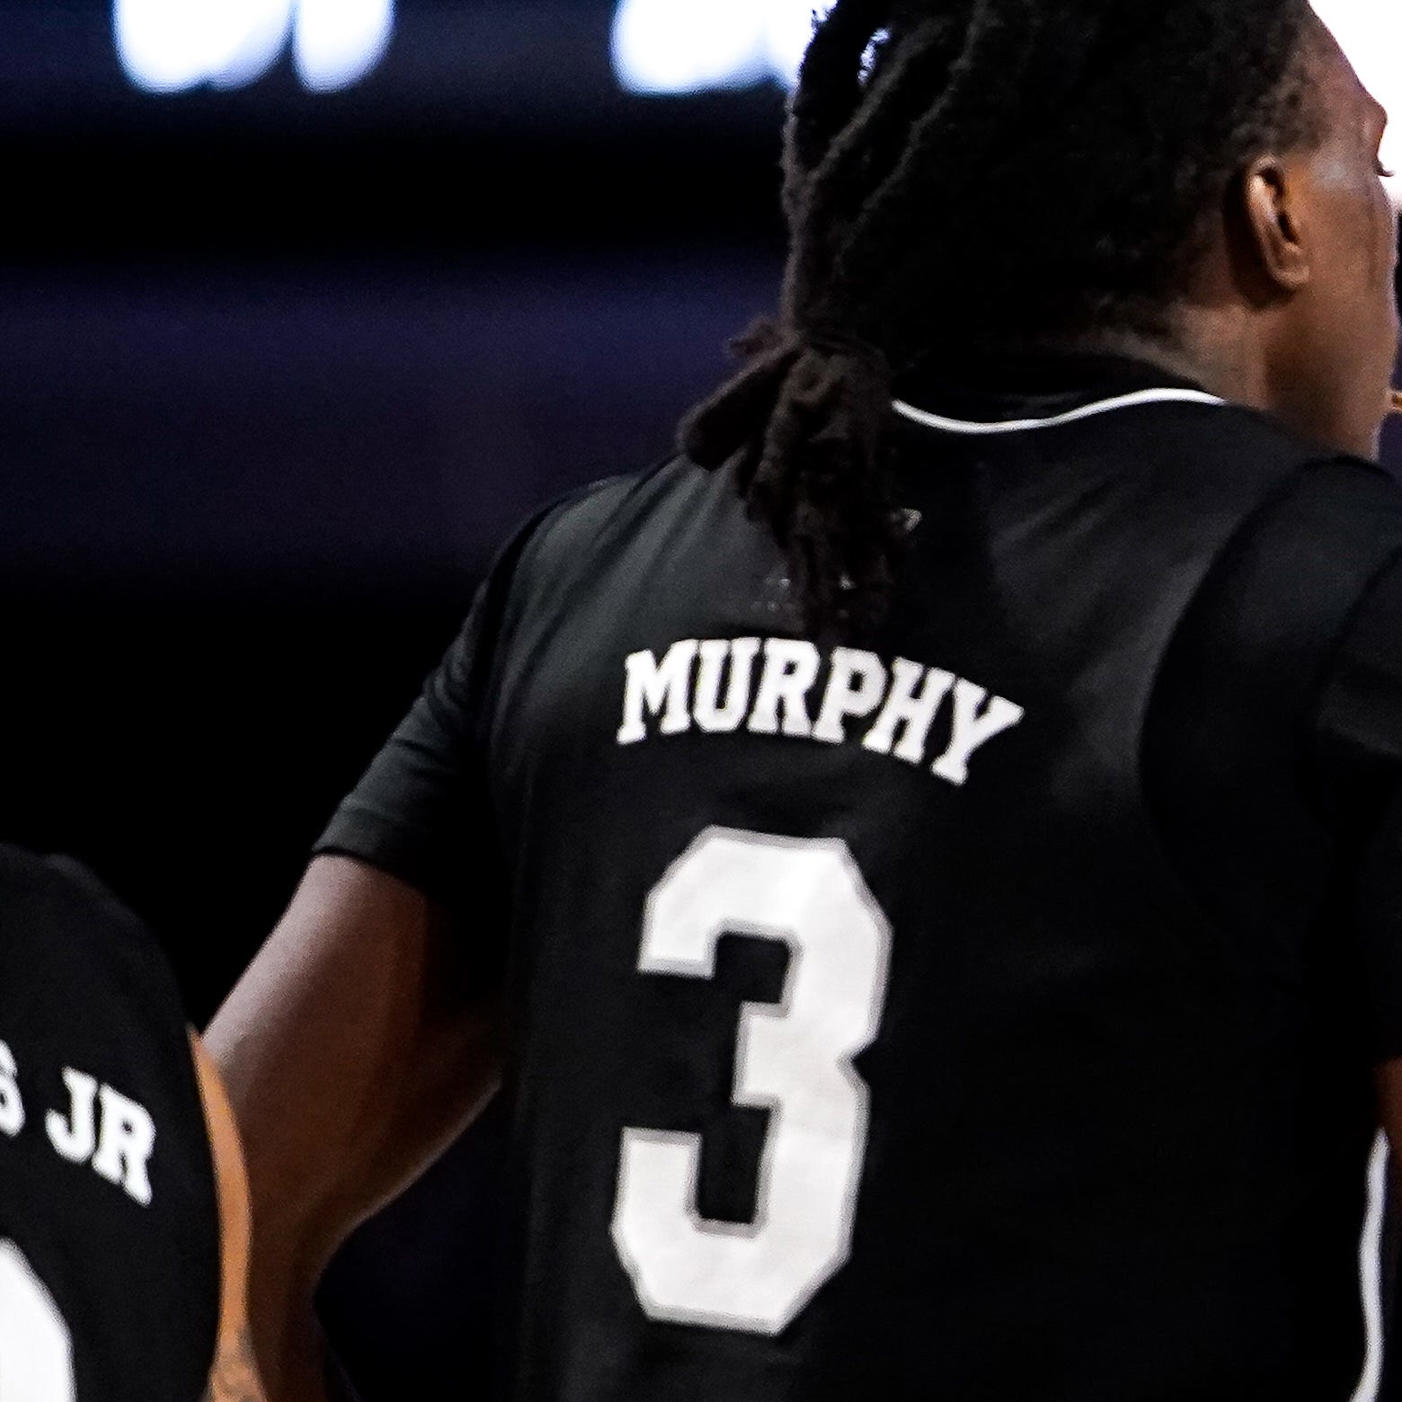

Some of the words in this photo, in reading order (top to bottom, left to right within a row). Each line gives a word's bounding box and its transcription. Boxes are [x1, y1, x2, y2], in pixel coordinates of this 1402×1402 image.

[617, 637, 1024, 784] MURPHY
[45, 1066, 157, 1207] JR
[610, 825, 895, 1336] 3
